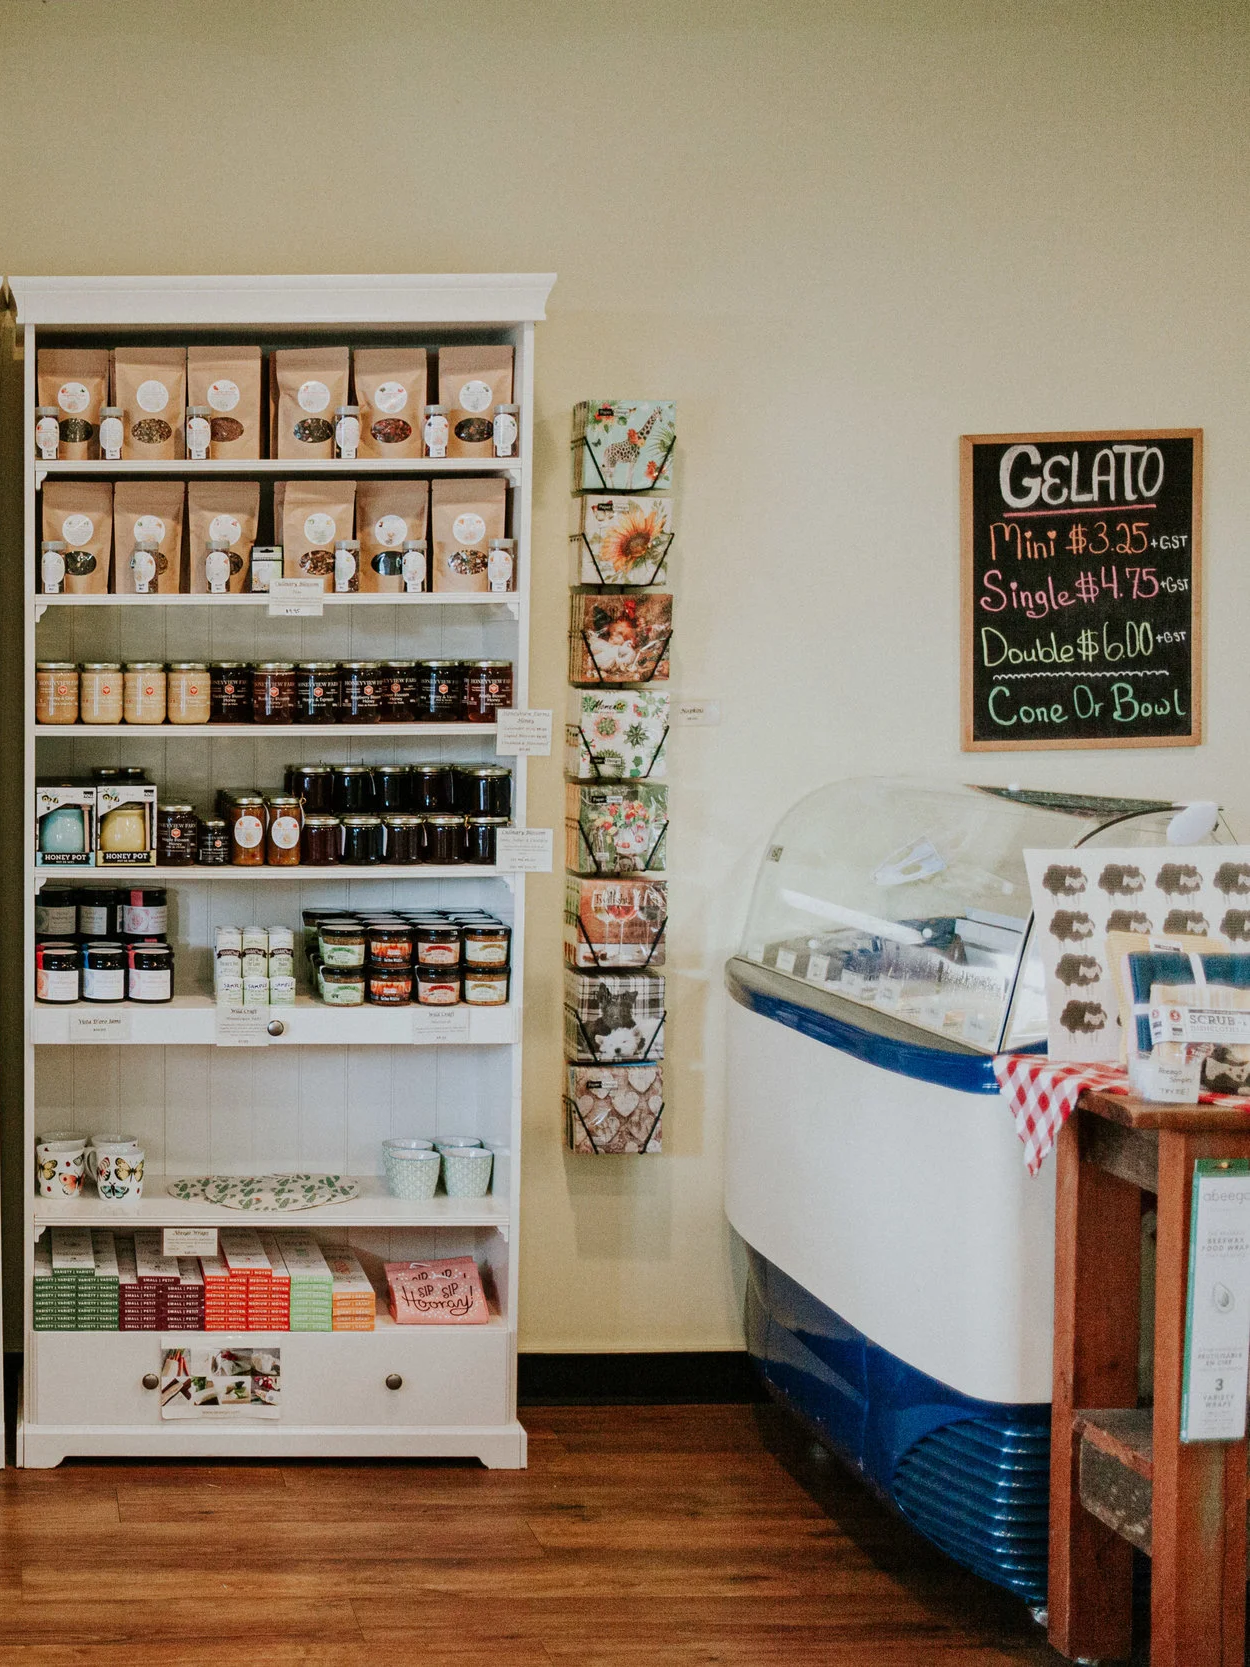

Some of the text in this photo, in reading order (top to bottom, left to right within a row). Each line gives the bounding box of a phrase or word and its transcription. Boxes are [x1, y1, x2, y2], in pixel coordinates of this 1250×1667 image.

[999, 444, 1164, 508] GELATO
[989, 521, 1188, 561] Mini $3.25 +GST
[980, 565, 1189, 619] Single $4.75 +GST
[981, 621, 1187, 667] Double $6.00 +GST
[988, 682, 1187, 726] Cone Or Bowl
[133, 852, 148, 860] POT
[1189, 1014, 1235, 1026] SCRUB
[417, 1282, 459, 1299] SIP SIP
[1215, 1378, 1224, 1391] 3
